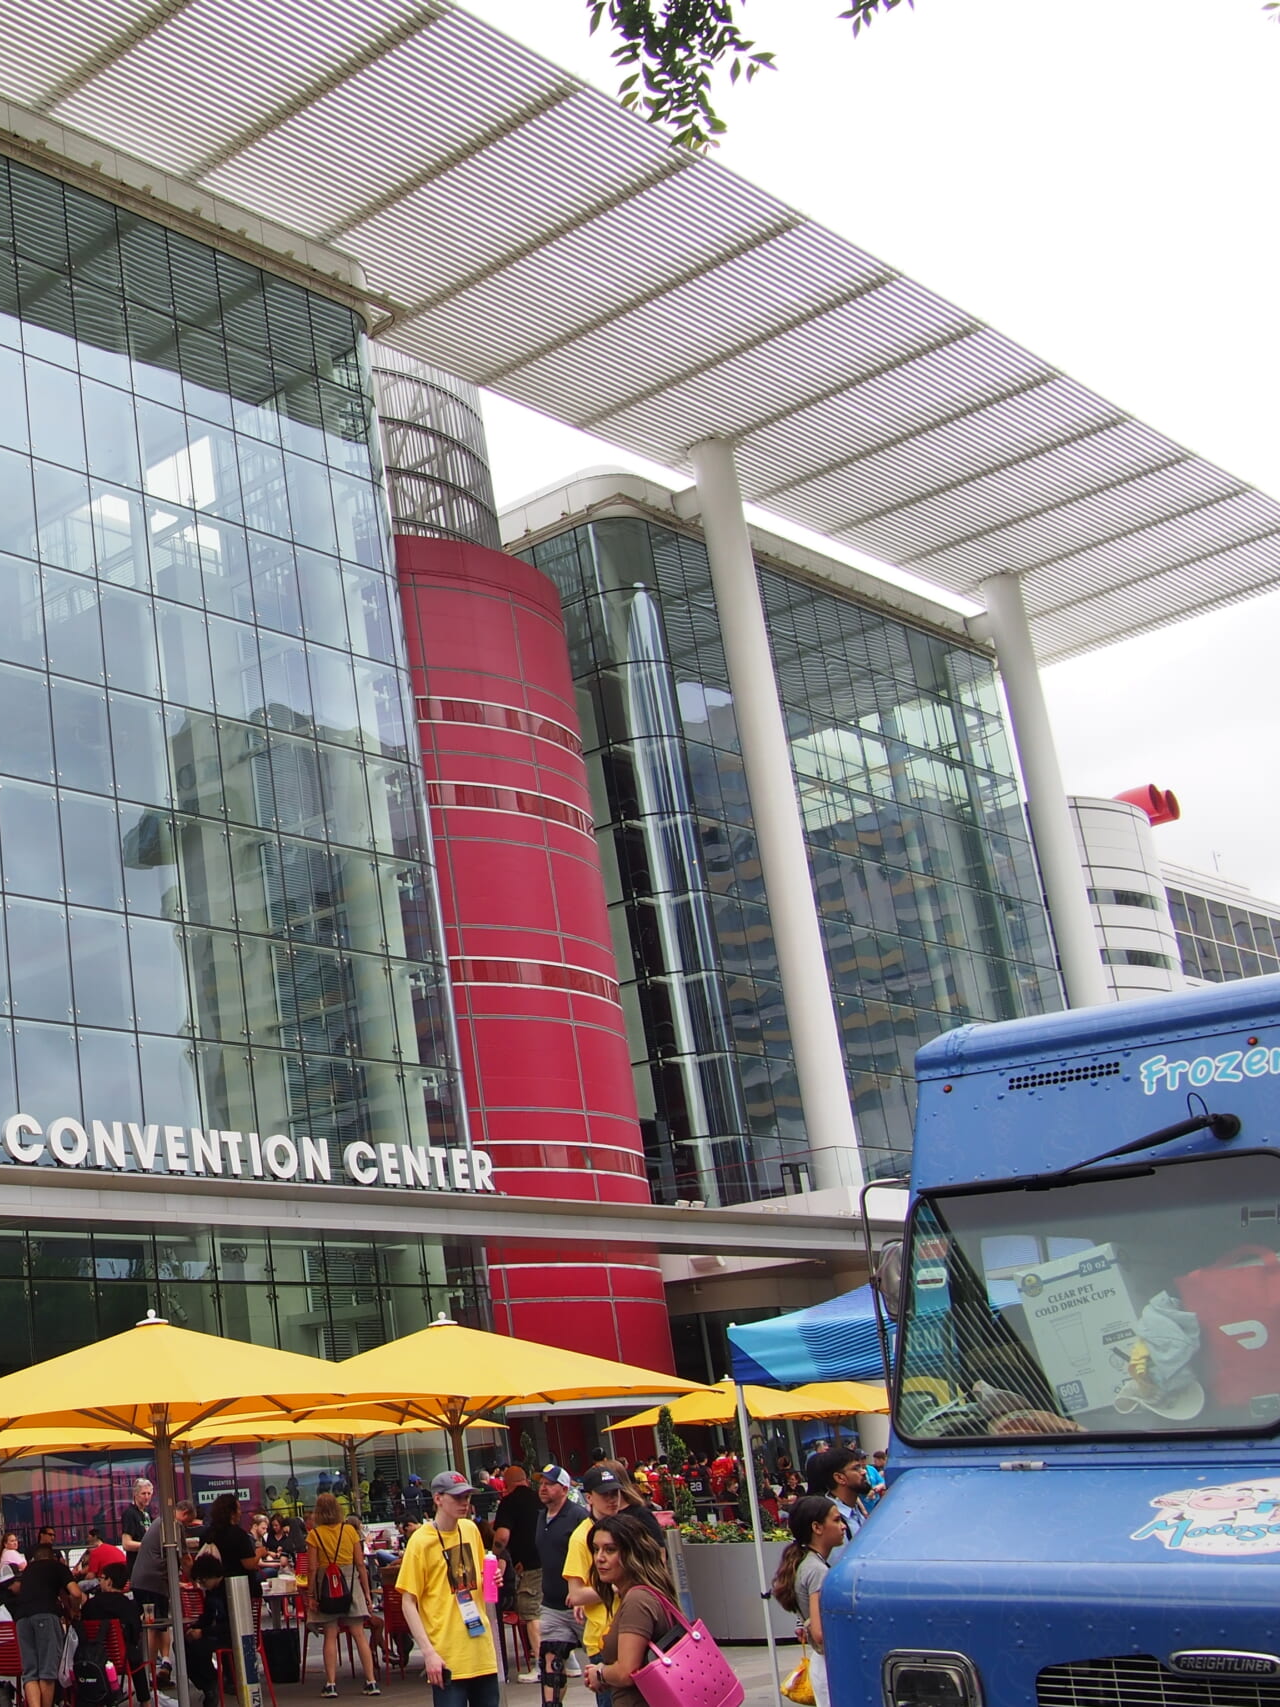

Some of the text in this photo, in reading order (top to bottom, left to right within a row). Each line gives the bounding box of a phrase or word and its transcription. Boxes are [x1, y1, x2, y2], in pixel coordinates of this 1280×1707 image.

[1, 1112, 331, 1182] CONVENTION
[343, 1141, 496, 1192] CENTER
[1080, 1263, 1094, 1273] 20
[1035, 1287, 1117, 1318] COLD DRINK CUPS
[1048, 1283, 1095, 1304] CLEAR PET
[1059, 1383, 1080, 1397] 600
[1180, 1656, 1272, 1672] FREIGHTLINER
